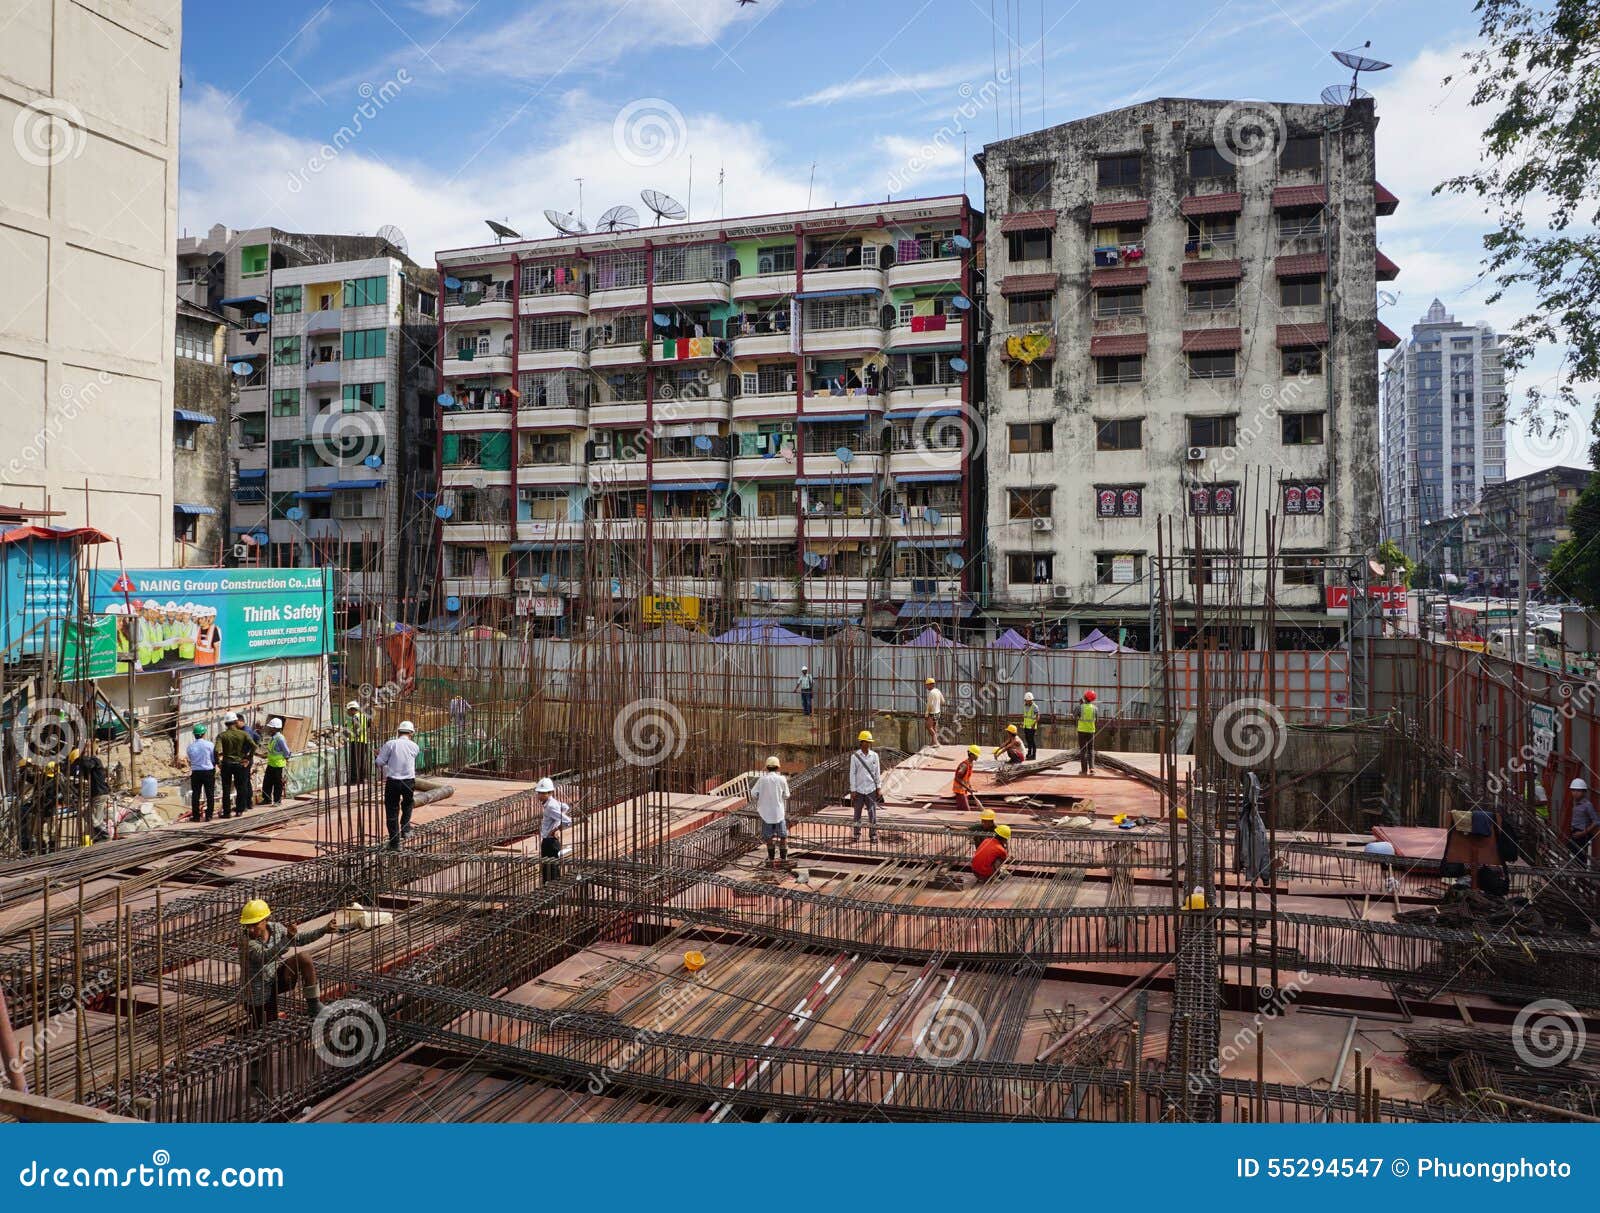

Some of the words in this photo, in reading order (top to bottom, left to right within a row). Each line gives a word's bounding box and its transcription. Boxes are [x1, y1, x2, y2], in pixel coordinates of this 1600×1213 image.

[140, 580, 181, 592] NAING
[184, 579, 218, 593] Group
[220, 576, 287, 591] Construction
[243, 606, 280, 623] Think
[283, 603, 322, 622] Safety
[247, 629, 263, 637] YOUR
[308, 625, 318, 633] AND
[249, 639, 277, 647] COMPANY
[277, 637, 298, 645] DEPEND
[307, 635, 317, 643] YOU
